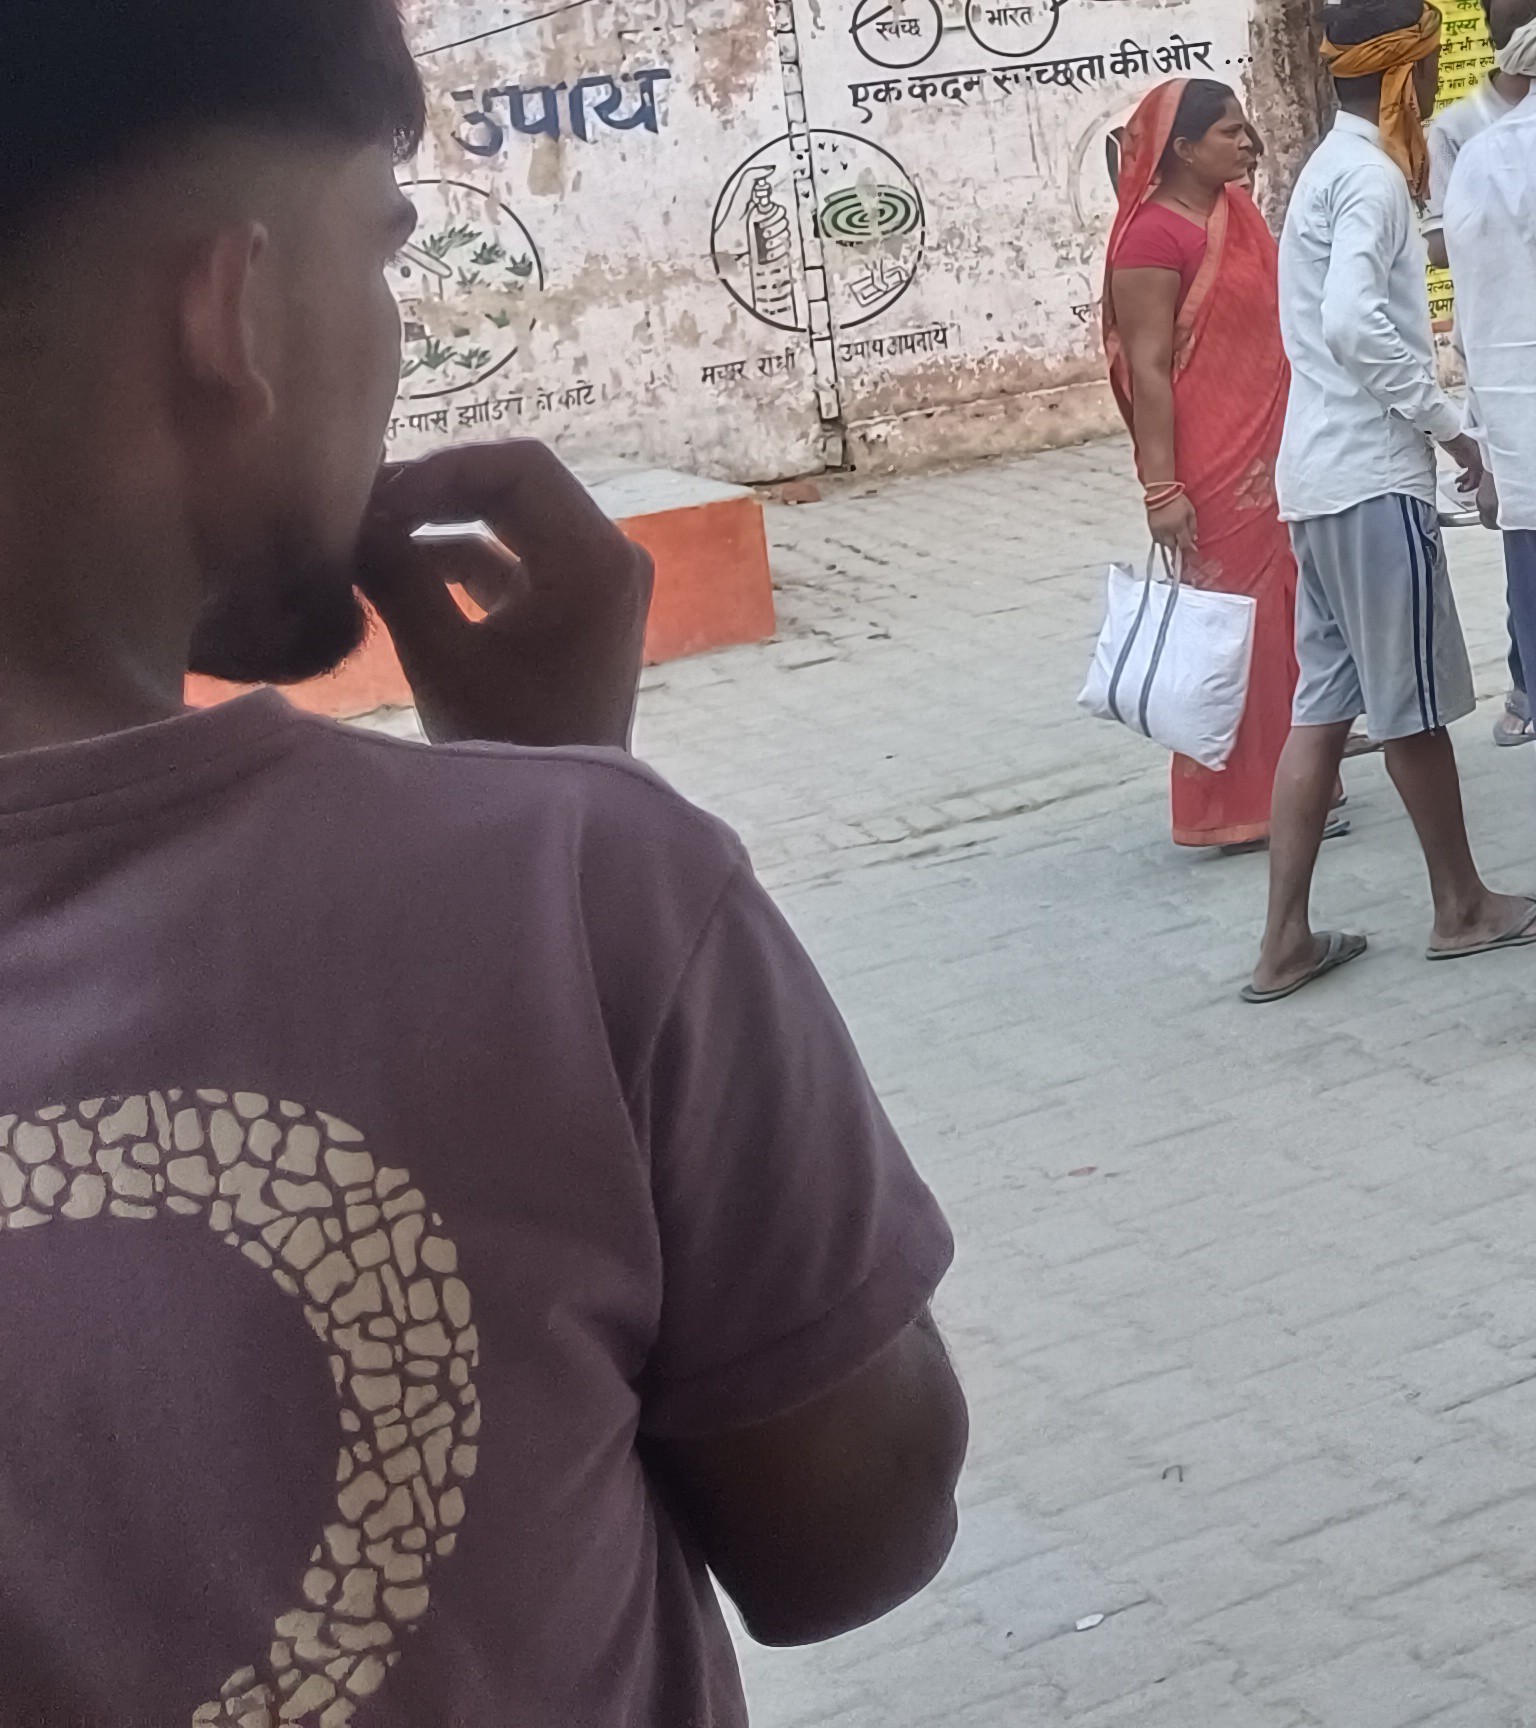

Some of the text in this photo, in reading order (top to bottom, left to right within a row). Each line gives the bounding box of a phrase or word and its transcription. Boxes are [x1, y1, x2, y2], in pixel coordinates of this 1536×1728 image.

[986, 5, 1034, 28] भारत
[450, 67, 672, 158] उपाय
[846, 78, 903, 124] एक
[1110, 38, 1150, 77] की
[1153, 33, 1215, 70] ओर
